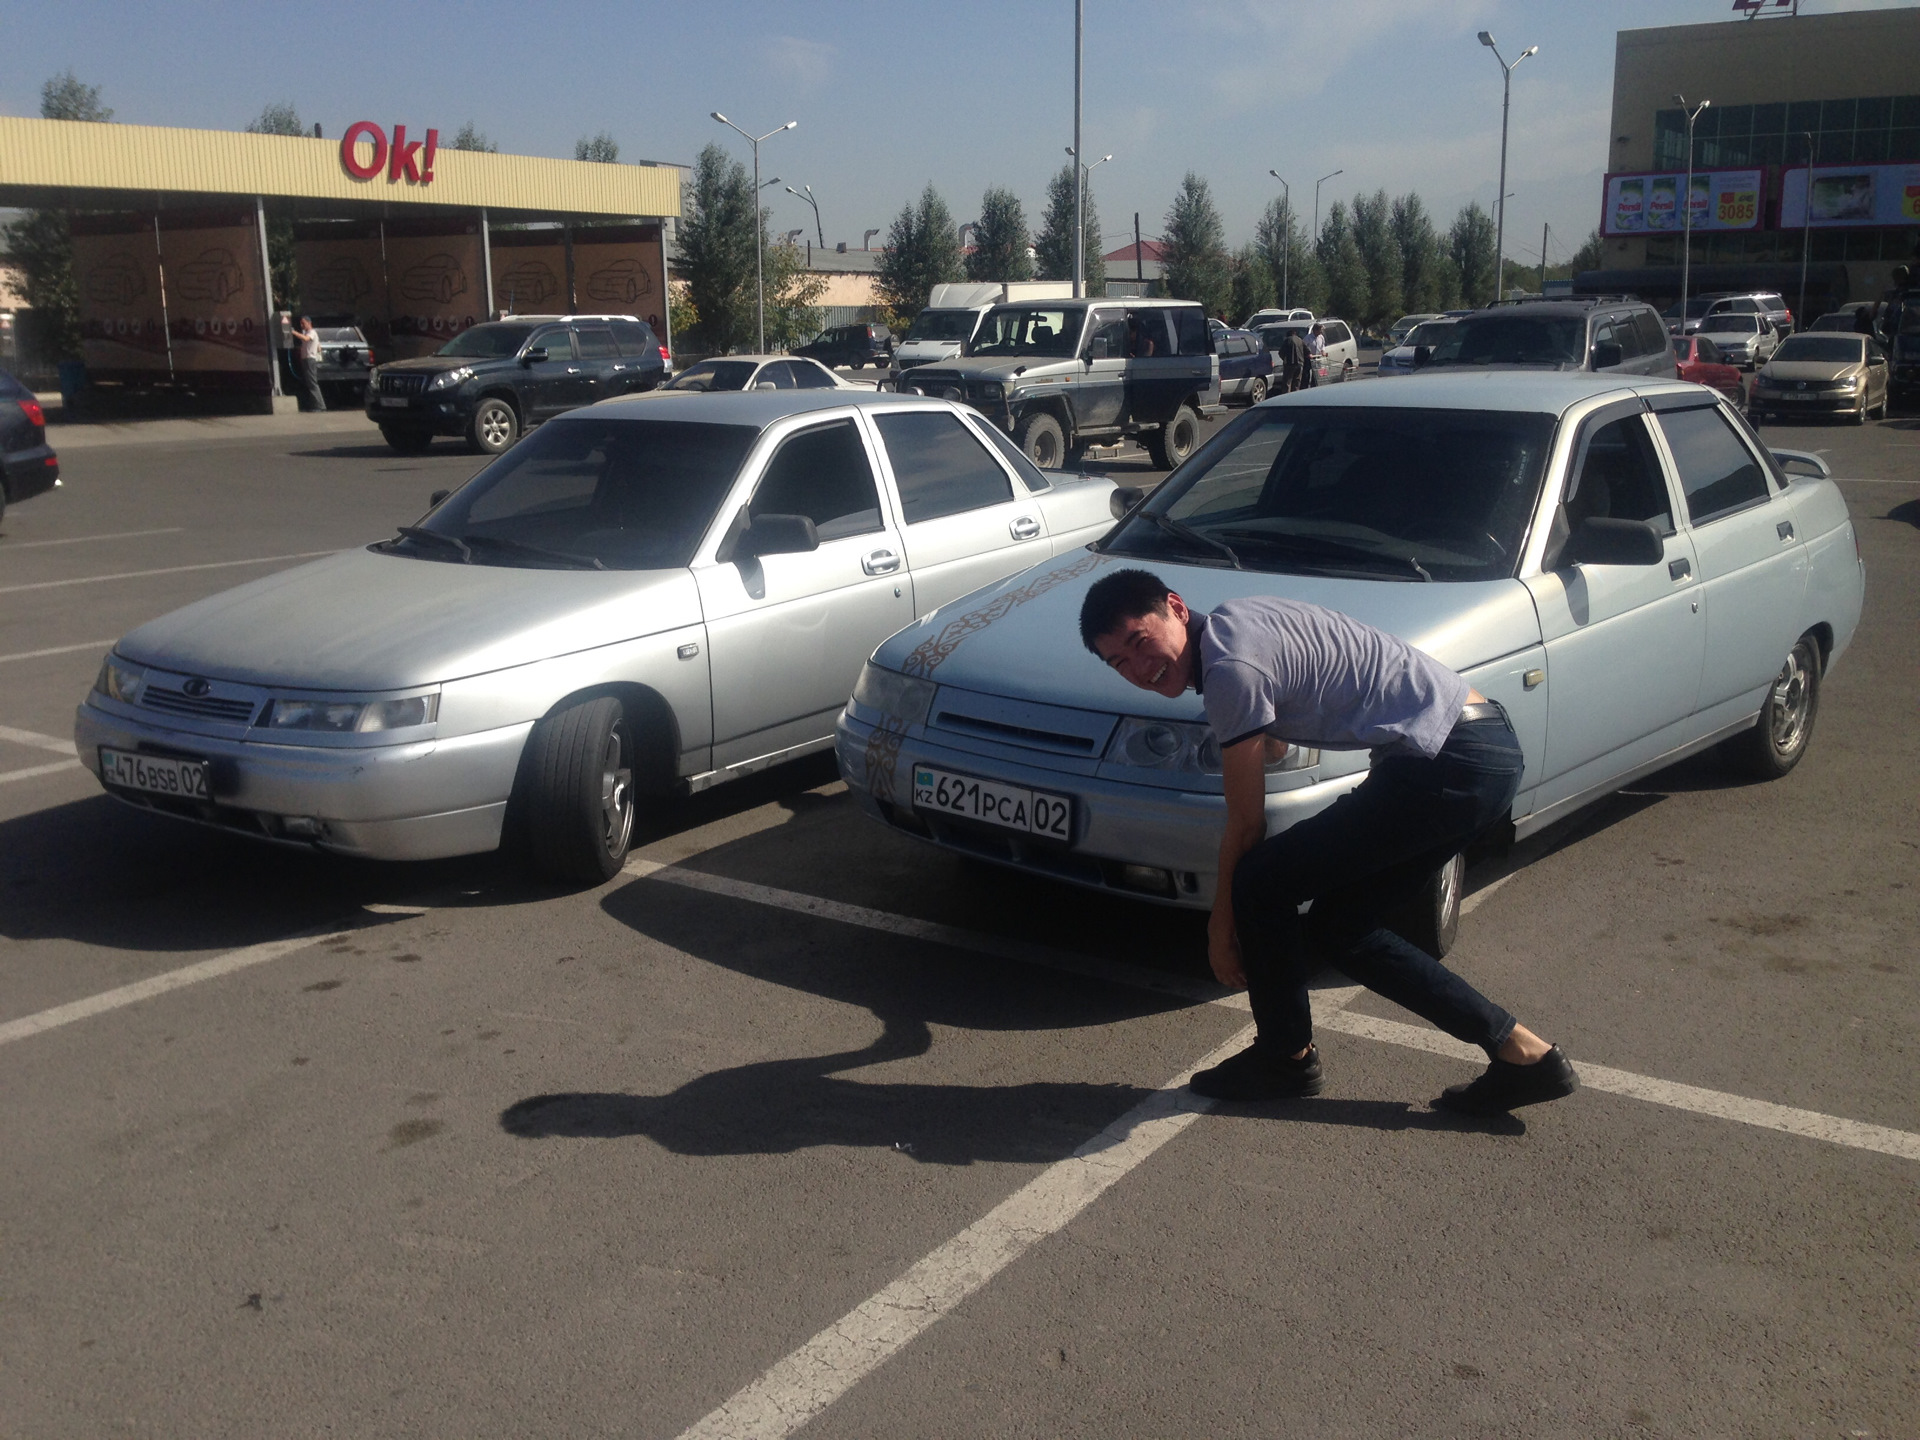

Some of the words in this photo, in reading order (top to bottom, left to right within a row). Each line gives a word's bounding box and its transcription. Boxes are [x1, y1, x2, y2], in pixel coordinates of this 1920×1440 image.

[341, 120, 438, 183] Ok!
[1718, 204, 1754, 219] 3085
[1034, 797, 1067, 836] 02
